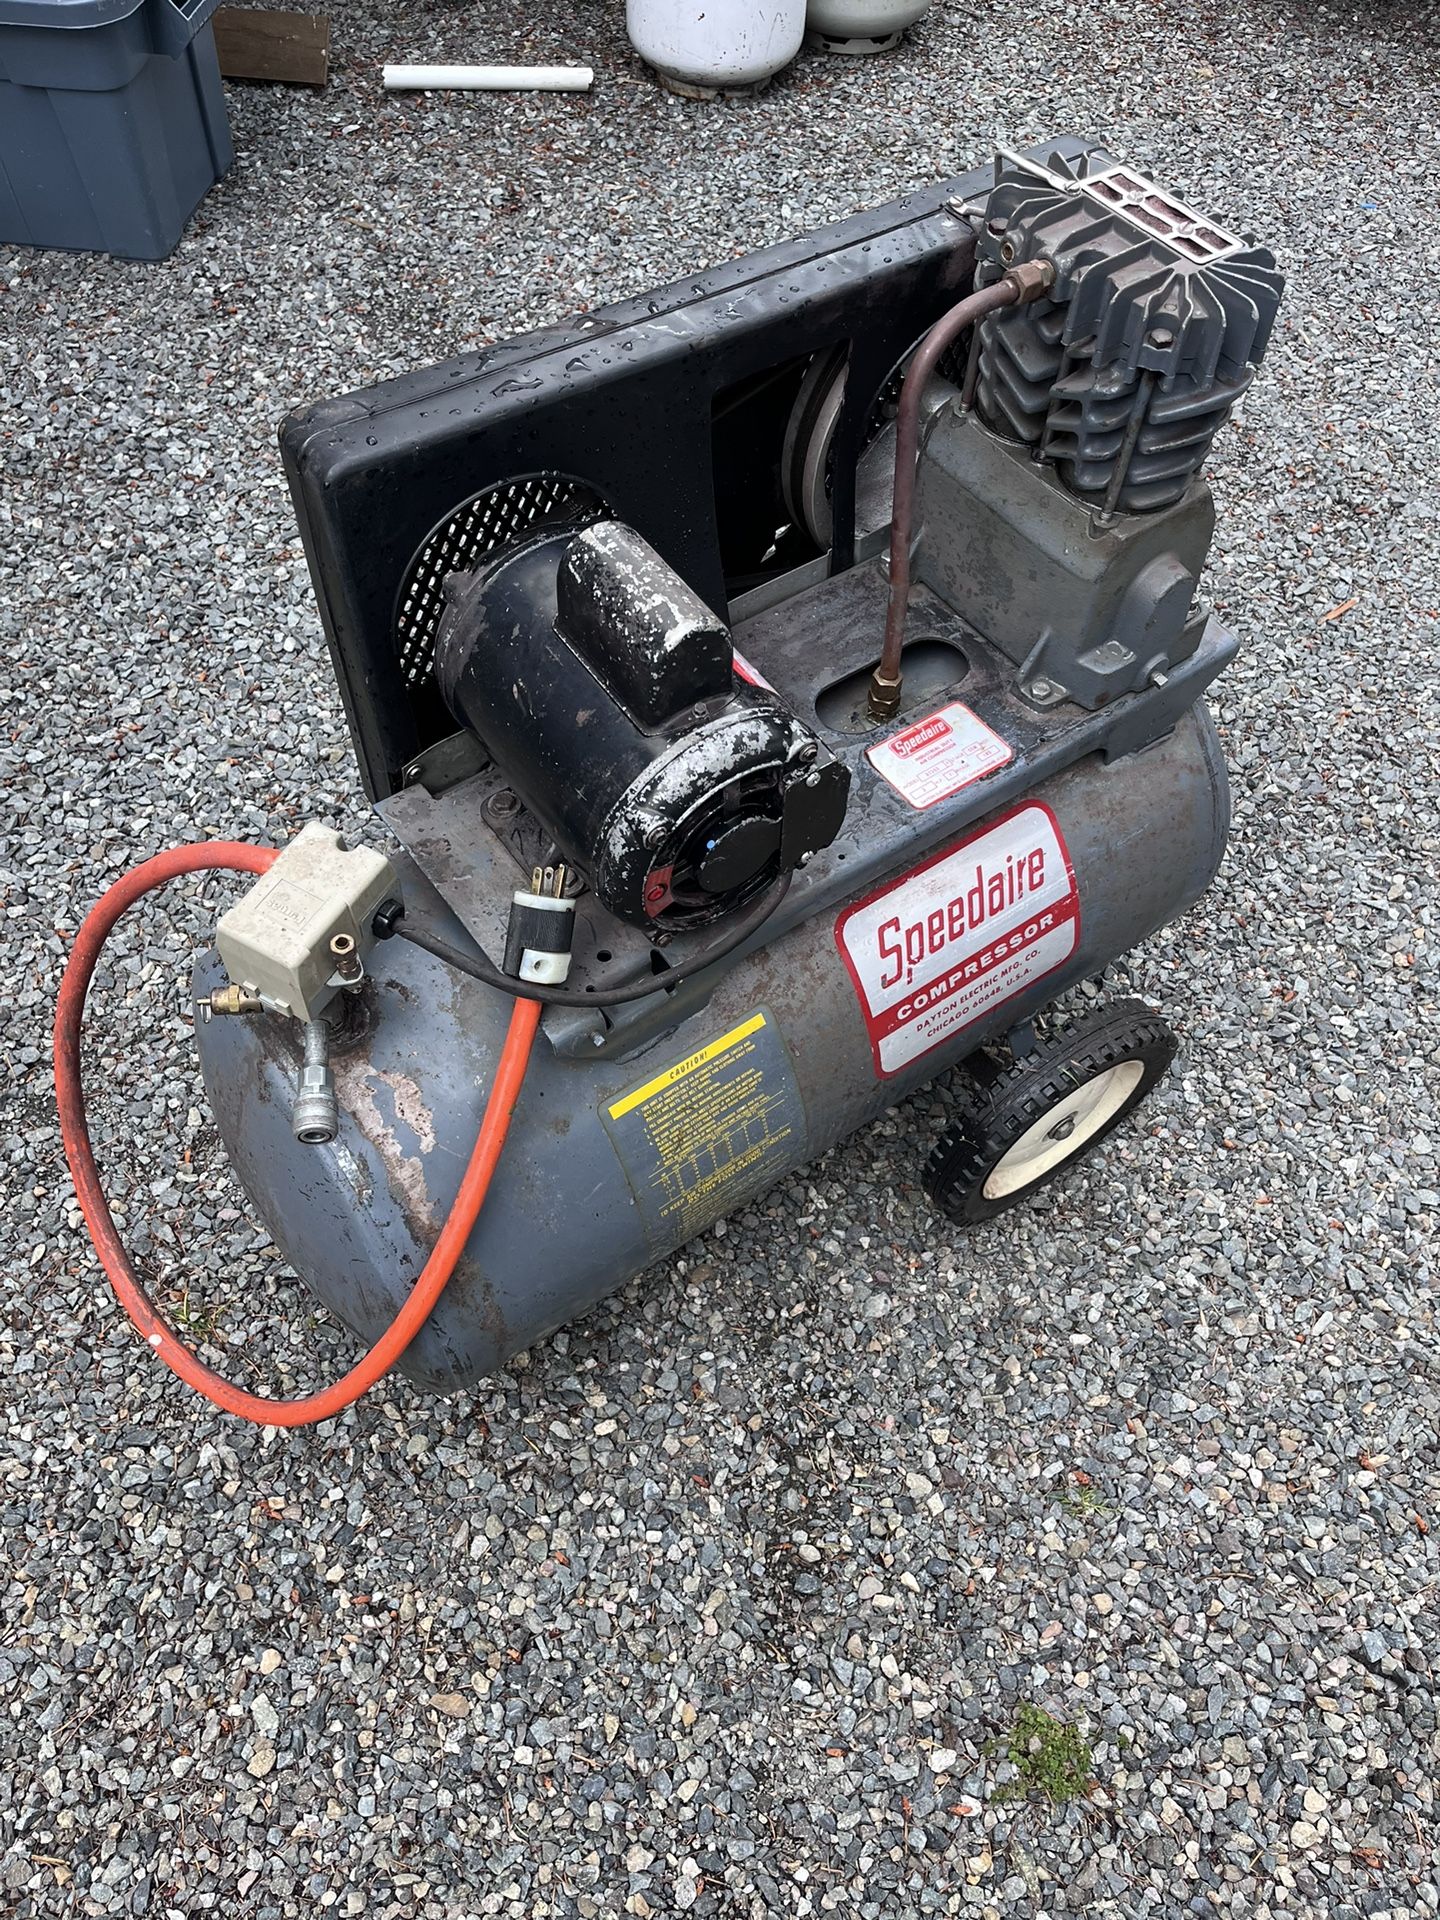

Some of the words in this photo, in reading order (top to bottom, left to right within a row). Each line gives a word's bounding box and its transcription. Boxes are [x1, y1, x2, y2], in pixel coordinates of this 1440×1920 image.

[894, 720, 946, 756] Speedaire
[877, 847, 1045, 989] Speedaire
[896, 914, 1055, 1020] COMPRESSOR
[916, 1002, 958, 1032] DAYTON
[959, 975, 999, 1004] ELECTRIC
[1000, 961, 1023, 978] MFG.
[1025, 949, 1041, 963] CO.
[926, 1006, 970, 1038] CHICAGO
[972, 986, 1003, 1012] 60648,
[1005, 968, 1033, 987] U.S.A.
[669, 1051, 709, 1080] CAUTION!
[669, 1198, 685, 1211] KEEP
[697, 1164, 736, 1192] COMPRESSOR
